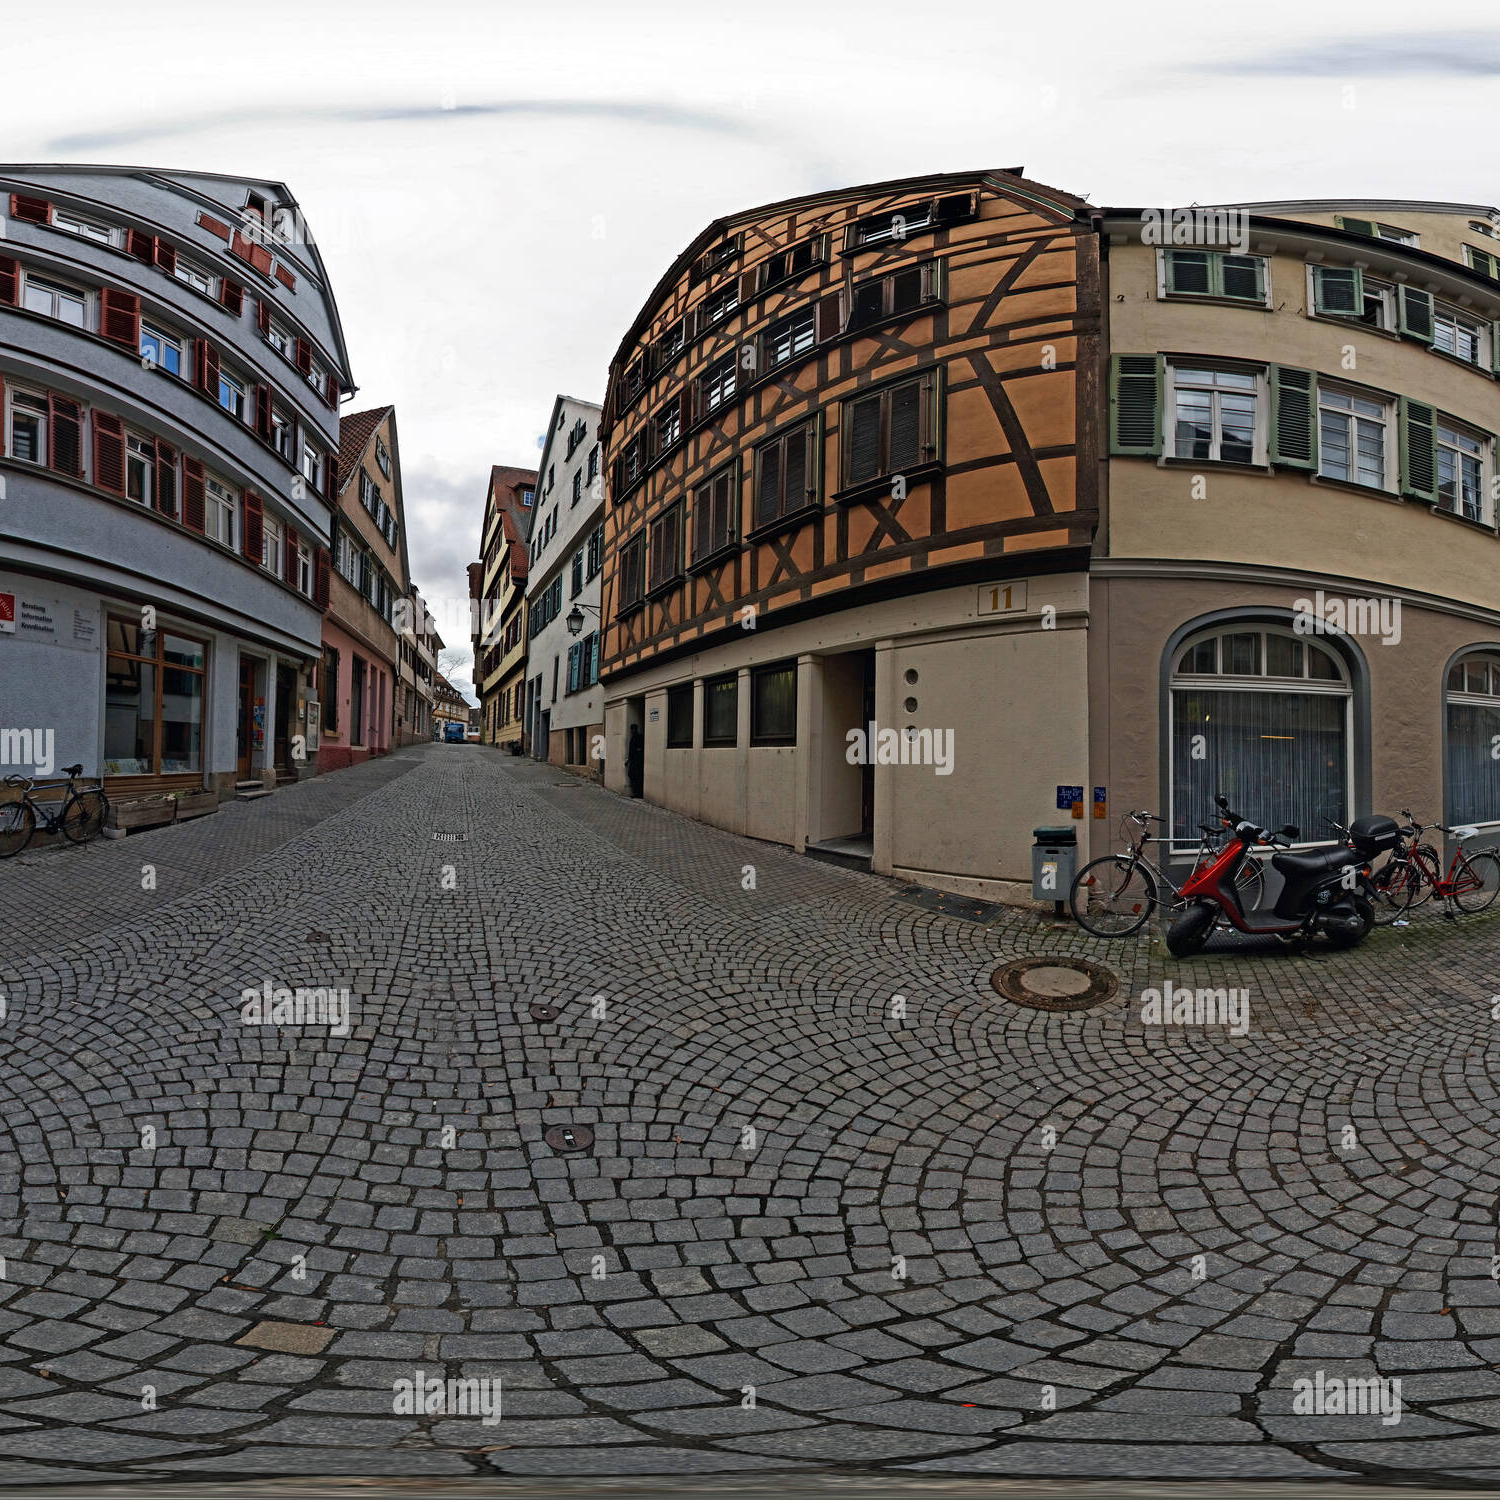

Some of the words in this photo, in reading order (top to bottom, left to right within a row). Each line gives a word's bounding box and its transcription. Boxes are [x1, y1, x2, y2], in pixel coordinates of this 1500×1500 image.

[990, 586, 1012, 611] 11
[22, 602, 45, 613] Beratung
[21, 611, 52, 622] Information
